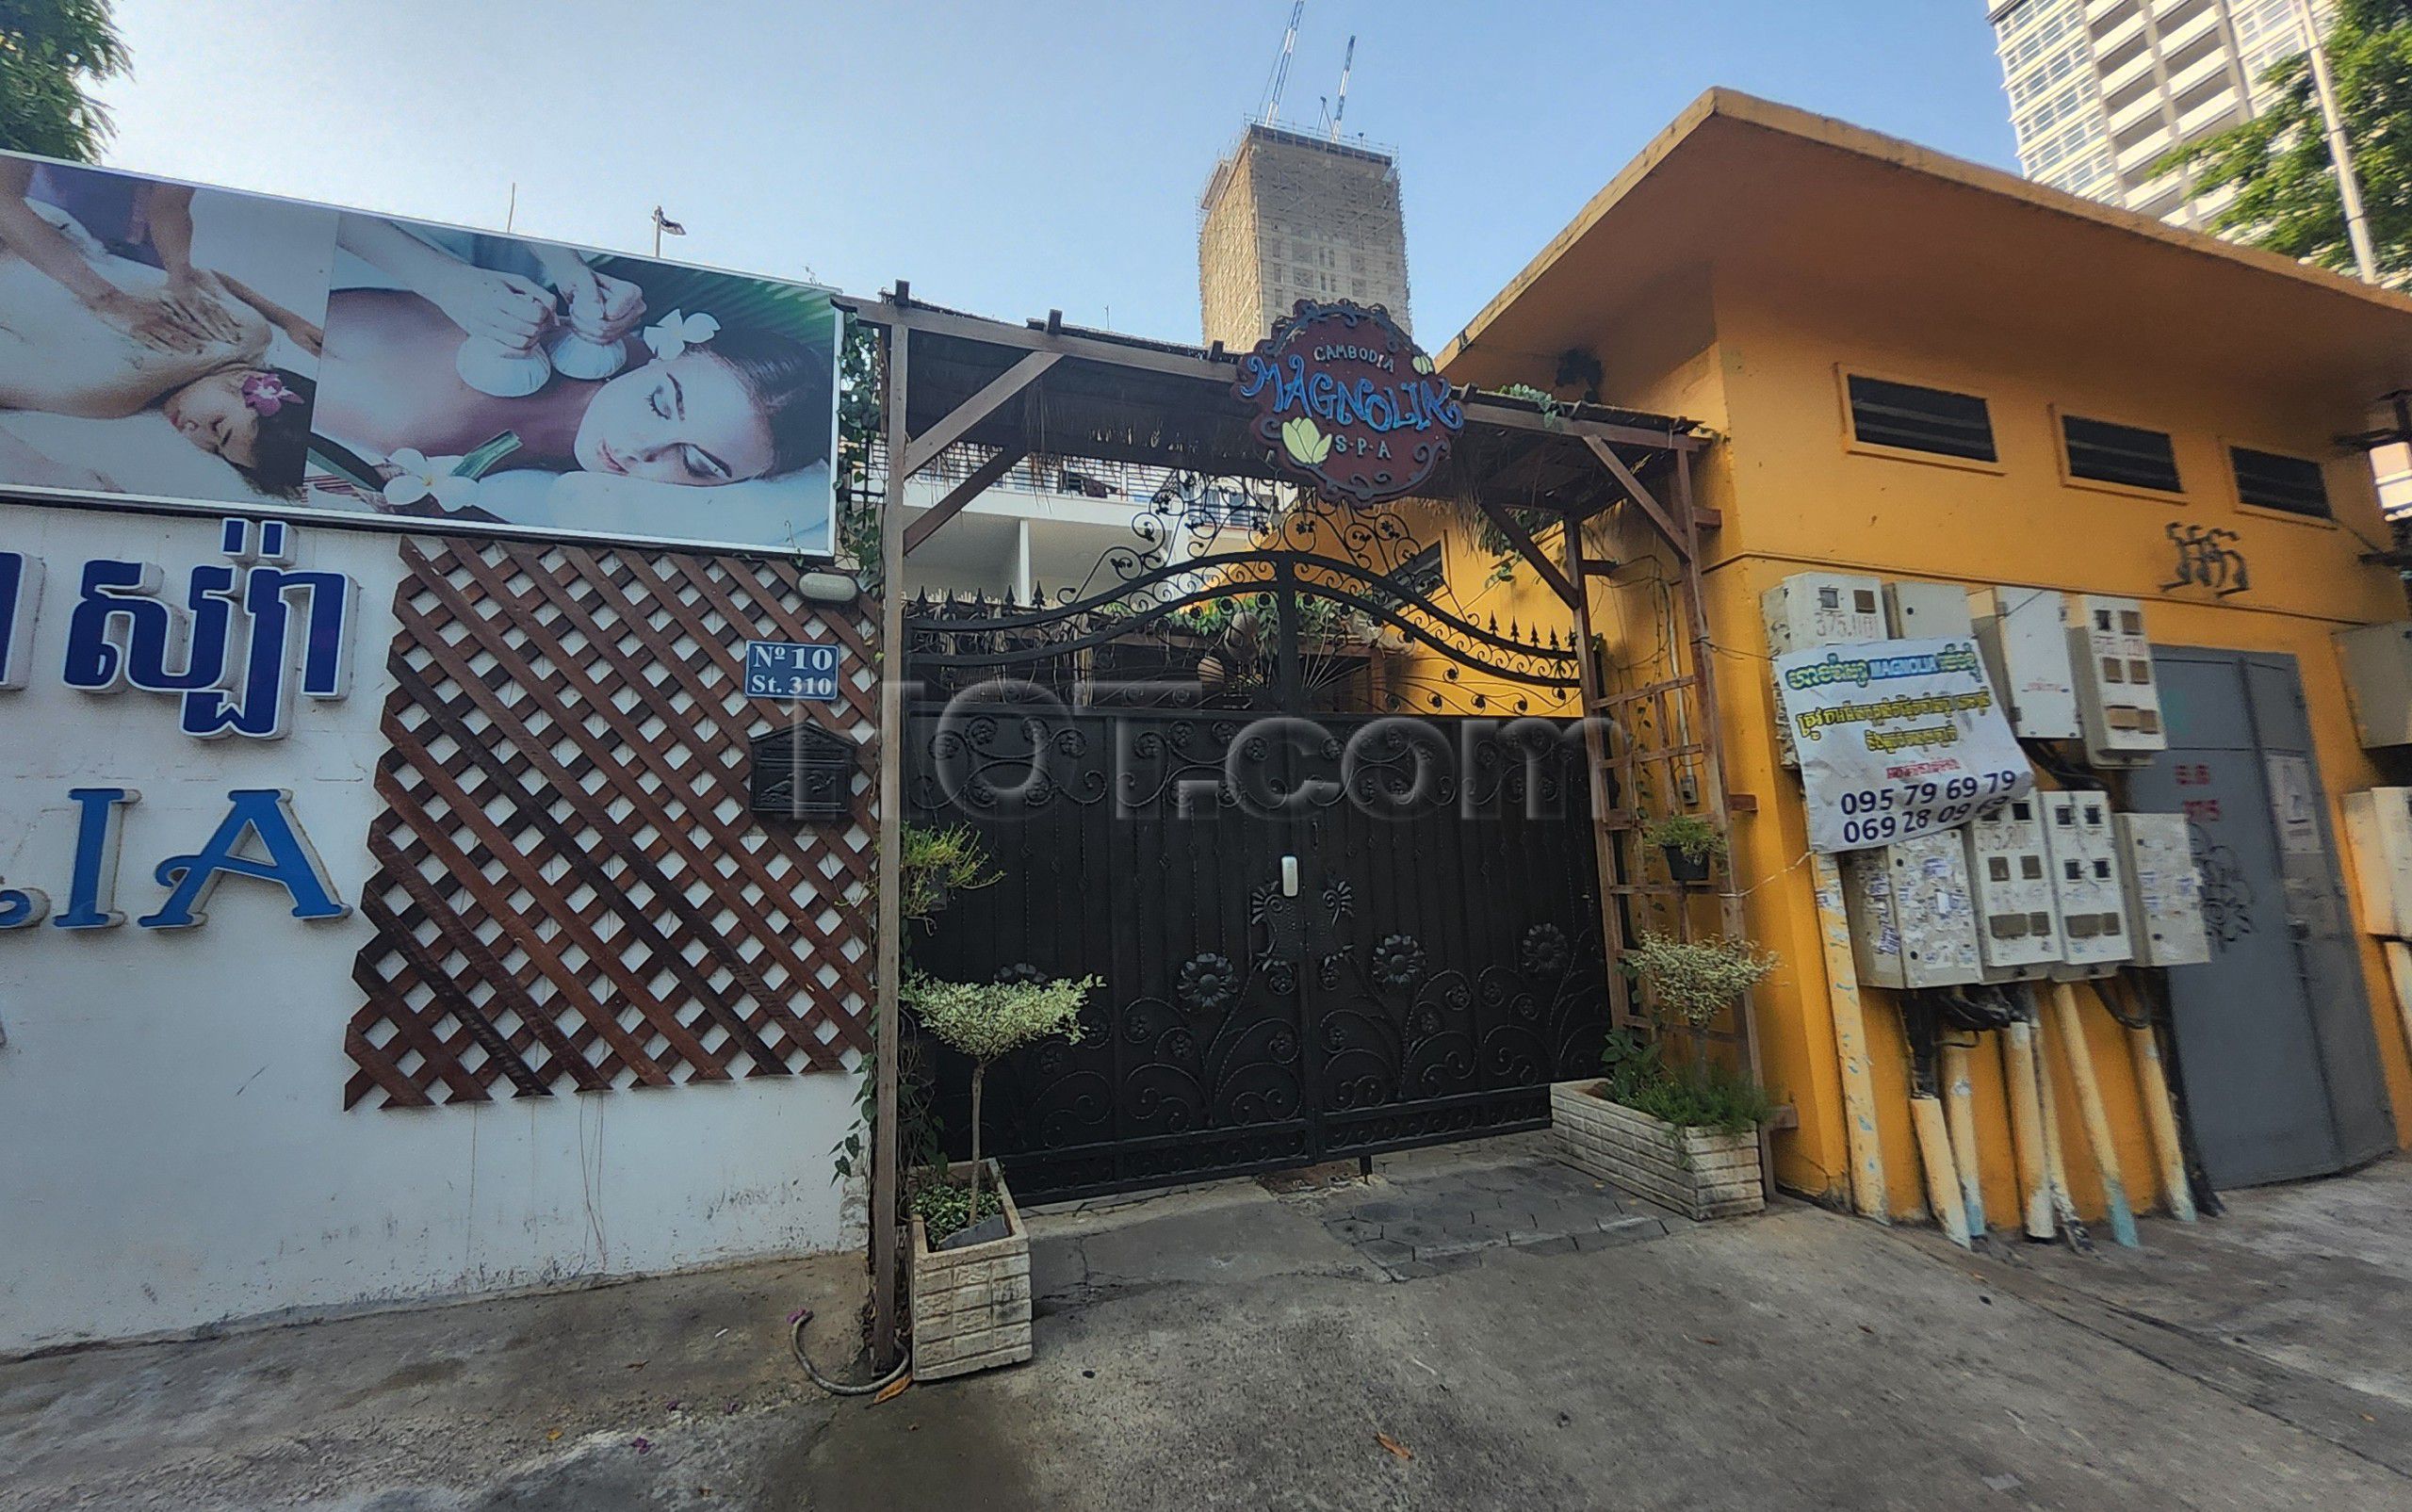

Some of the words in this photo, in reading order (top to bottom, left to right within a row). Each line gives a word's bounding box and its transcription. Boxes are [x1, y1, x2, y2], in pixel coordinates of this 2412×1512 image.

[1312, 344, 1395, 373] CAMBODIA
[1240, 353, 1464, 432] MAGNOLIA
[791, 648, 833, 671] 10
[751, 675, 782, 693] St.
[788, 675, 832, 695] 310
[1841, 788, 1894, 816] 095
[1904, 783, 1937, 806] 79
[1946, 776, 1978, 800] 69
[1983, 770, 2016, 794] 79
[1843, 816, 1897, 843] 069
[1901, 808, 1931, 834] 28
[1937, 803, 1971, 823] 09
[0, 788, 344, 929] IA
